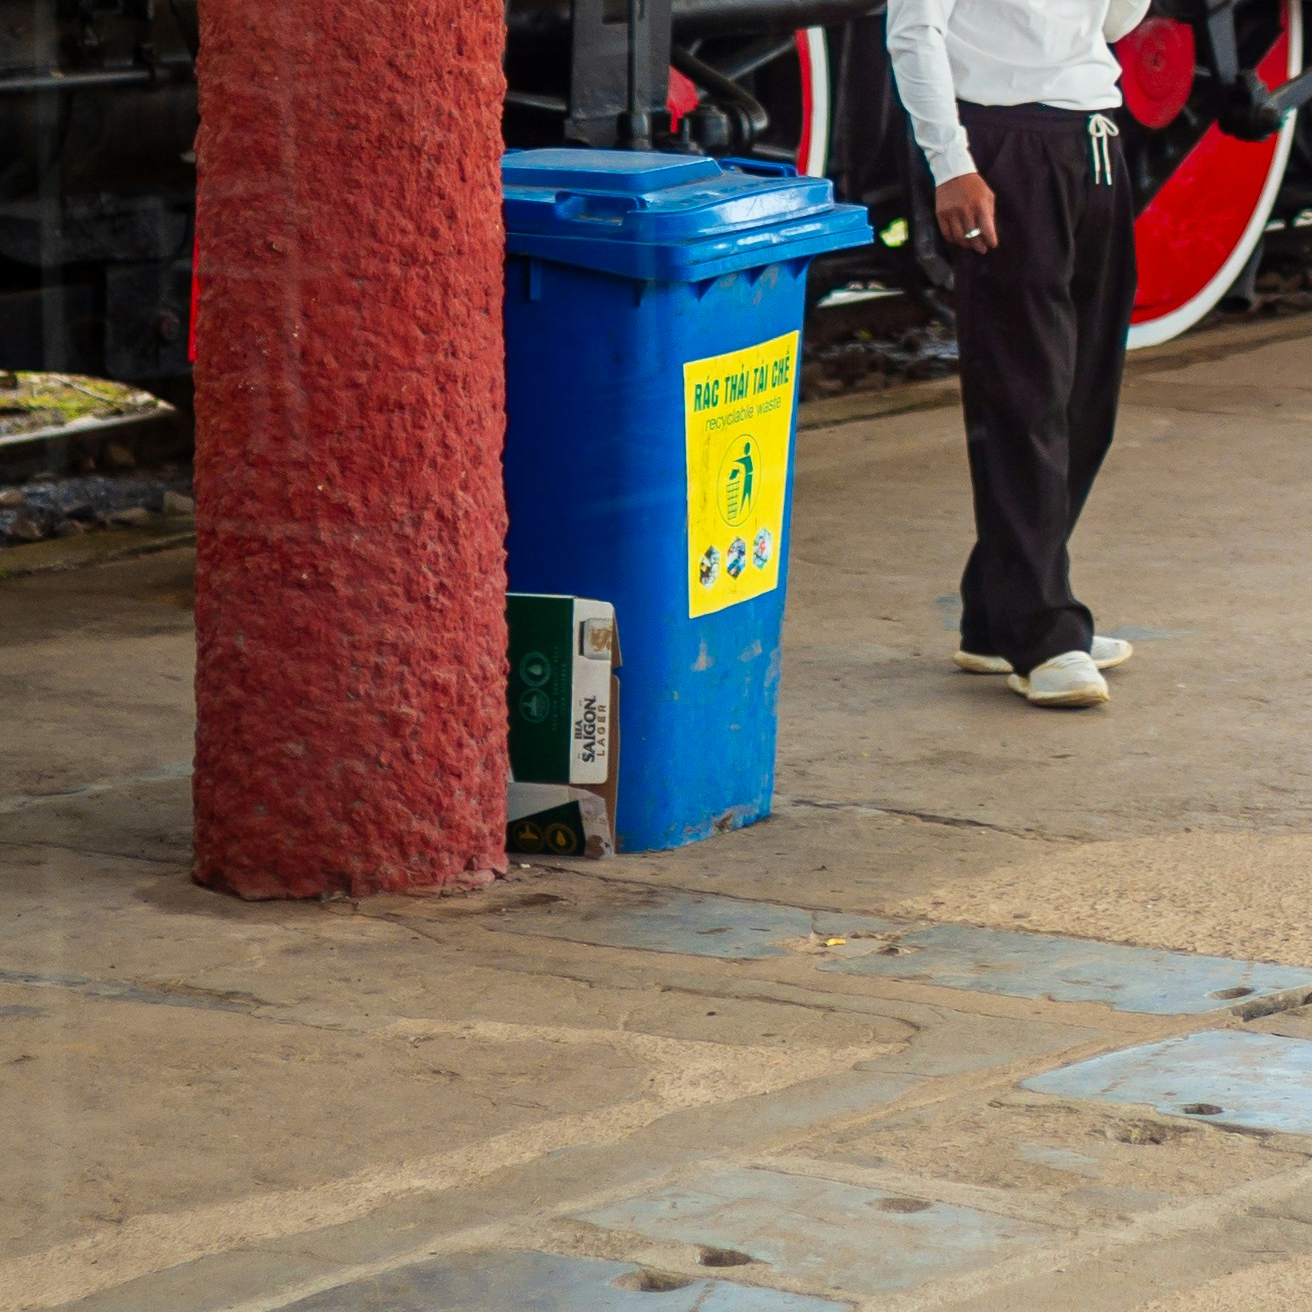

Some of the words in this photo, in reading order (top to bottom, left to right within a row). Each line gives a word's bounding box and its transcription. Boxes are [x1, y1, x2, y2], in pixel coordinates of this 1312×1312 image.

[694, 375, 720, 412] RÁC
[725, 363, 750, 404] THẢI
[753, 360, 769, 395] TÁI
[772, 345, 790, 388] CHẾ
[705, 405, 755, 431] recyclable
[757, 396, 781, 415] waste
[581, 697, 596, 763] SAIGON
[597, 704, 606, 757] LAGER
